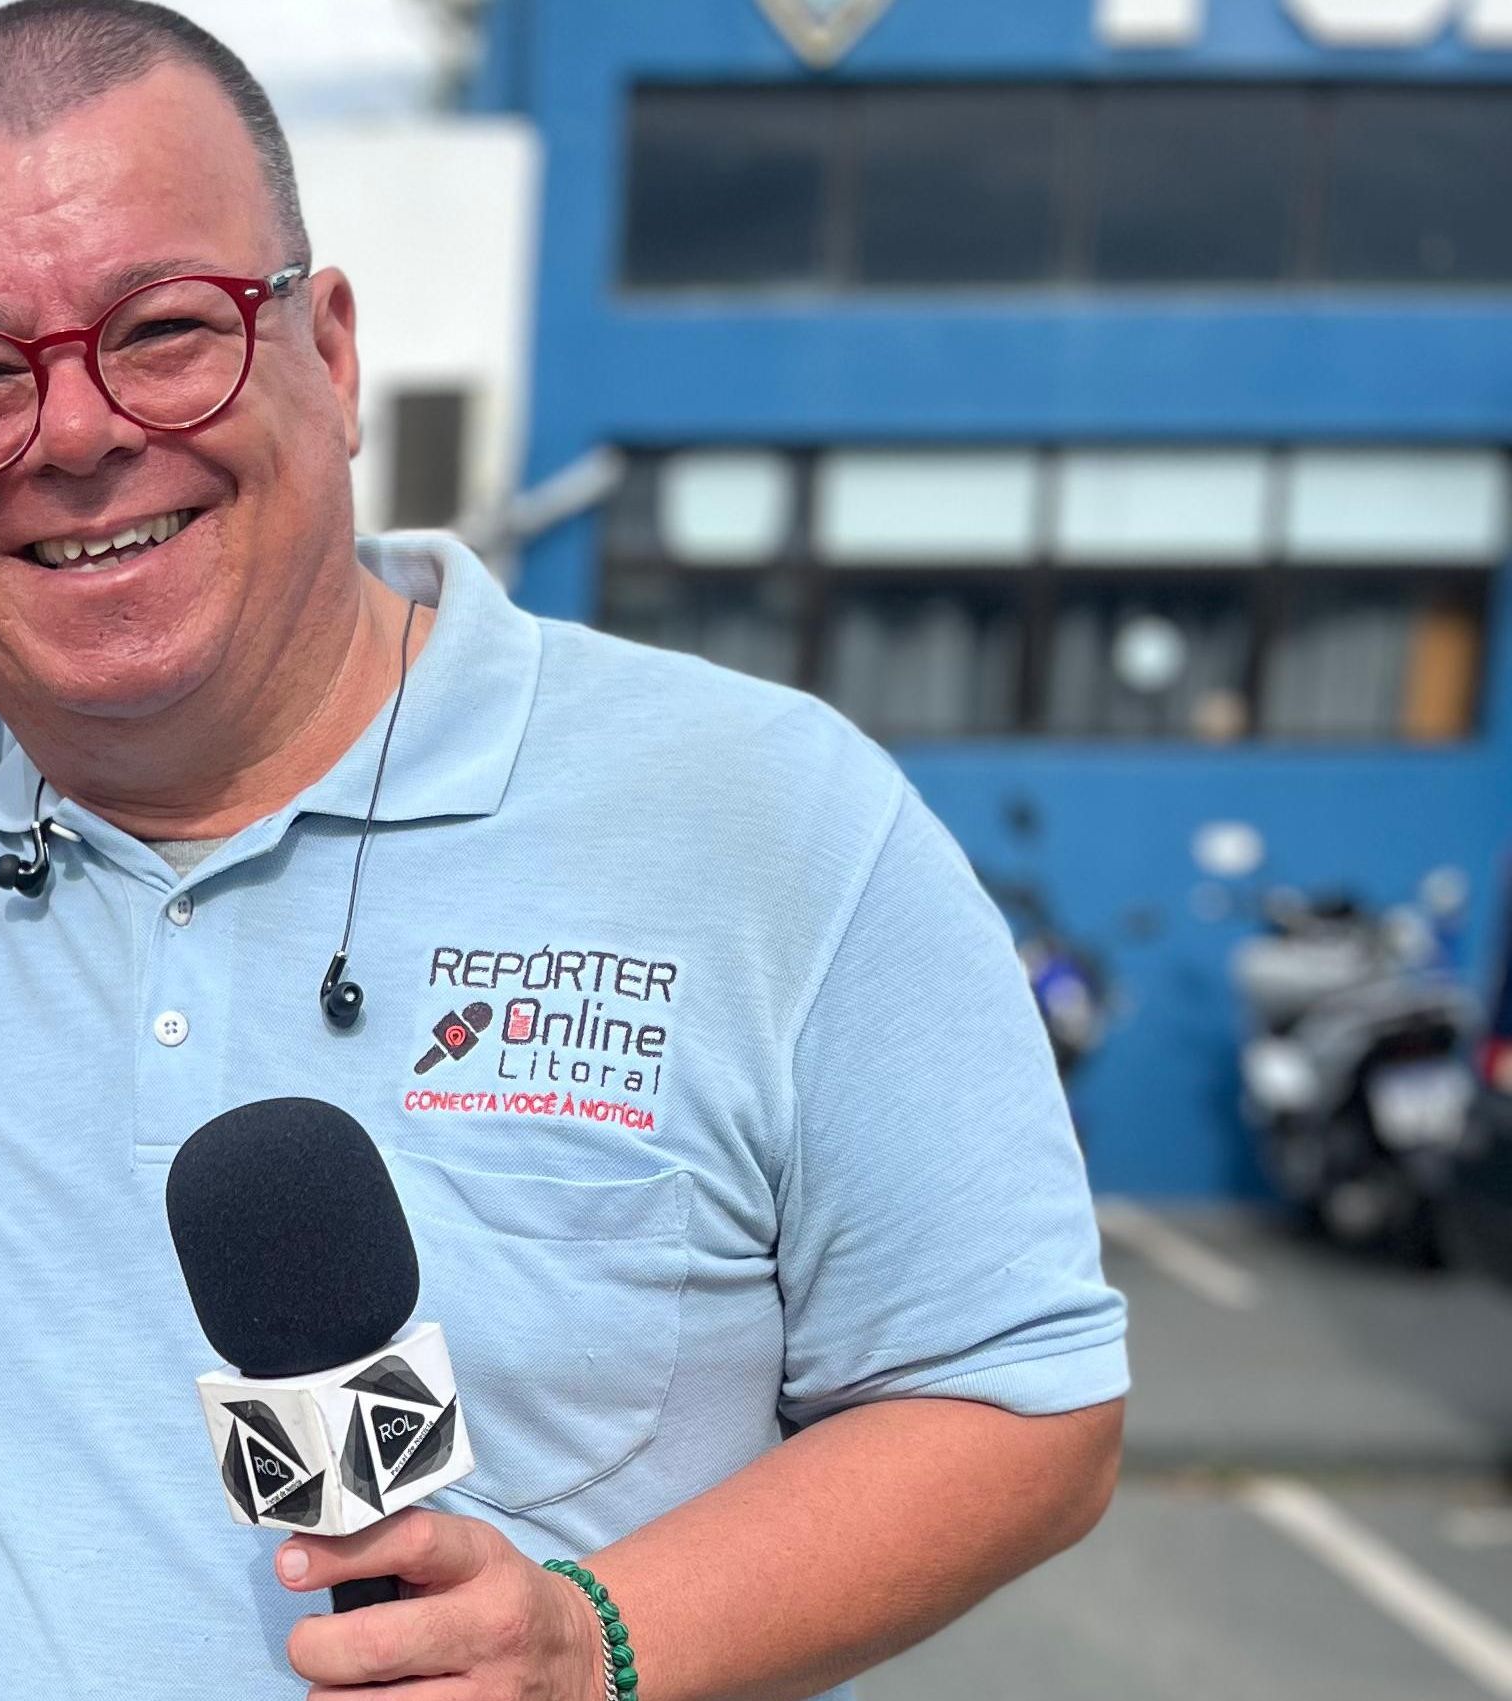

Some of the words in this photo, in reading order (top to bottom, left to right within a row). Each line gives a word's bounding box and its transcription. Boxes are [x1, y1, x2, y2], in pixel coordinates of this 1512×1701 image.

[429, 944, 677, 1002] REPÓRTER
[502, 998, 666, 1057] Online
[498, 1050, 660, 1095] Litoral
[403, 1090, 497, 1112] CONECTA
[502, 1091, 558, 1116] VOCÊ
[579, 1098, 655, 1131] NOTÍCIA
[378, 1414, 419, 1443] ROL
[253, 1455, 289, 1480] ROL
